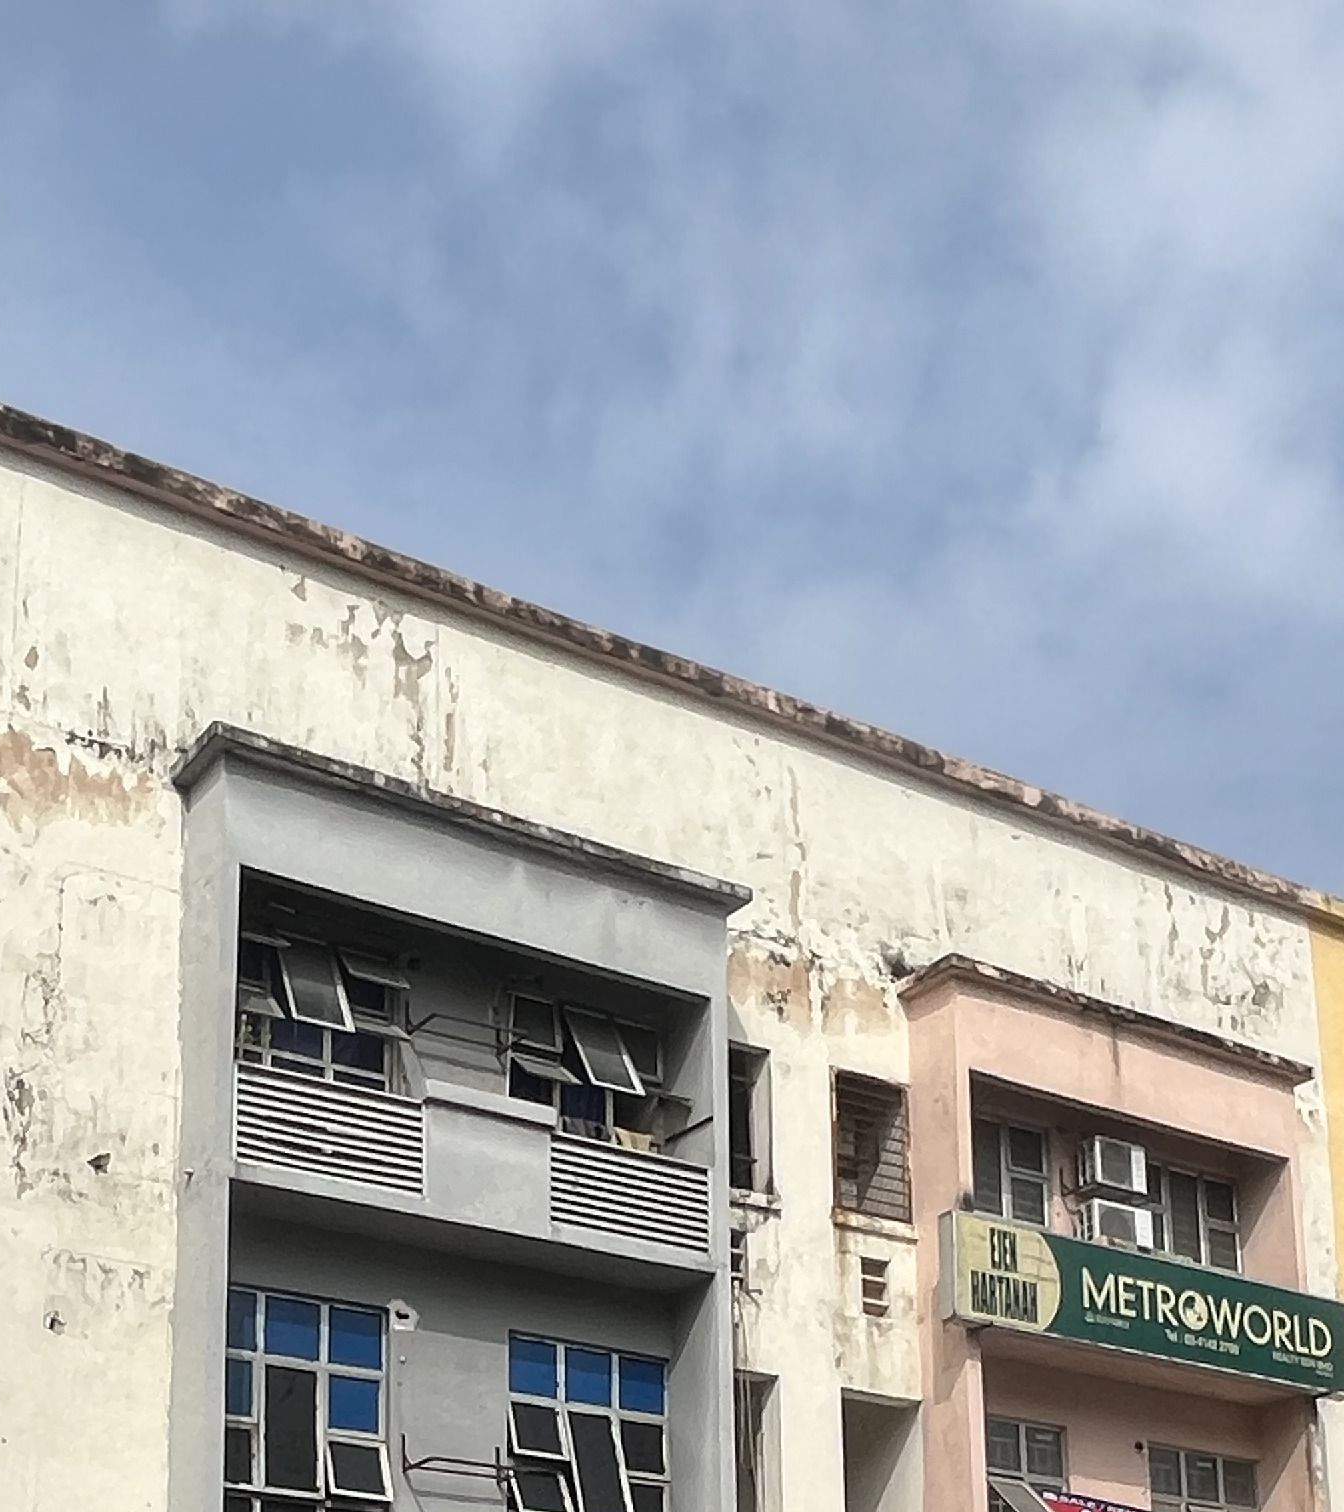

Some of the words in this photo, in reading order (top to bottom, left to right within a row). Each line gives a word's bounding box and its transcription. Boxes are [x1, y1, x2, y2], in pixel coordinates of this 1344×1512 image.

[989, 1227, 1017, 1273] EJEN
[971, 1269, 1038, 1324] HARTANAH
[1082, 1266, 1332, 1357] METROWORLD
